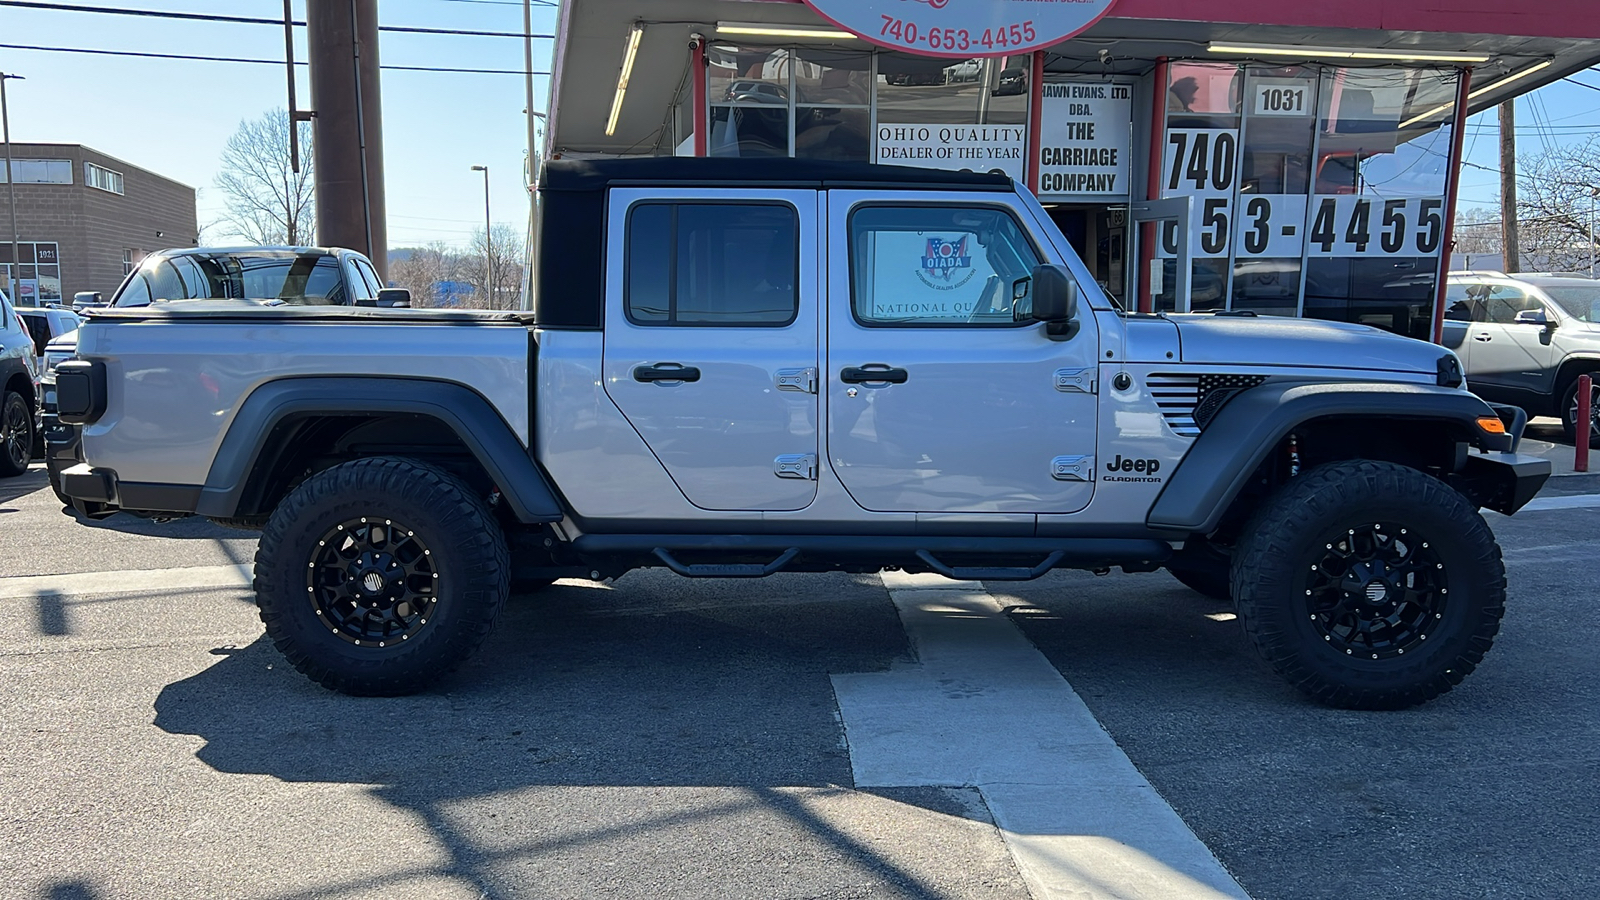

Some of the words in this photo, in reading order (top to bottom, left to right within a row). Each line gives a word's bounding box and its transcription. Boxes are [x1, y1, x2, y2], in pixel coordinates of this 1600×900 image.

[879, 14, 1036, 50] 740-653-4455
[1111, 87, 1130, 100] LTD.
[1261, 88, 1303, 111] 1031
[1069, 103, 1093, 116] DBA.
[879, 127, 930, 142] OHIO
[939, 127, 1024, 144] QUALITY
[1066, 122, 1095, 141] THE
[881, 147, 933, 160] DEALER
[936, 147, 954, 160] OF
[957, 147, 984, 160] THE
[986, 147, 1021, 160] YEAR
[1041, 148, 1118, 167] CARRIAGE
[1168, 132, 1235, 191] 740
[1041, 173, 1117, 193] COMPANY
[927, 257, 963, 268] OIADA
[876, 303, 948, 313] NATIONAL
[1107, 455, 1160, 475] Jeep
